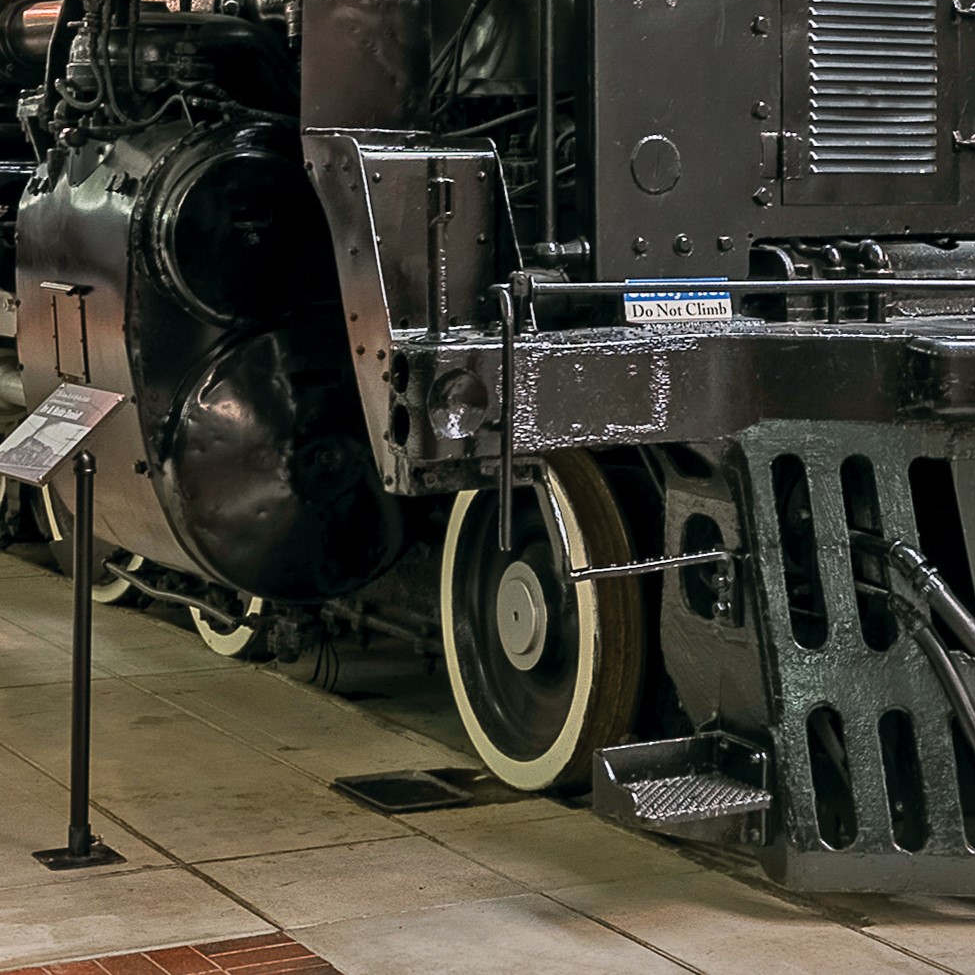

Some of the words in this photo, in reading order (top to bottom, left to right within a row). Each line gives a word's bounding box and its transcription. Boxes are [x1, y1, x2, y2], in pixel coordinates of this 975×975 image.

[632, 304, 653, 318] Do
[656, 303, 682, 317] Not
[686, 302, 727, 316] Climb
